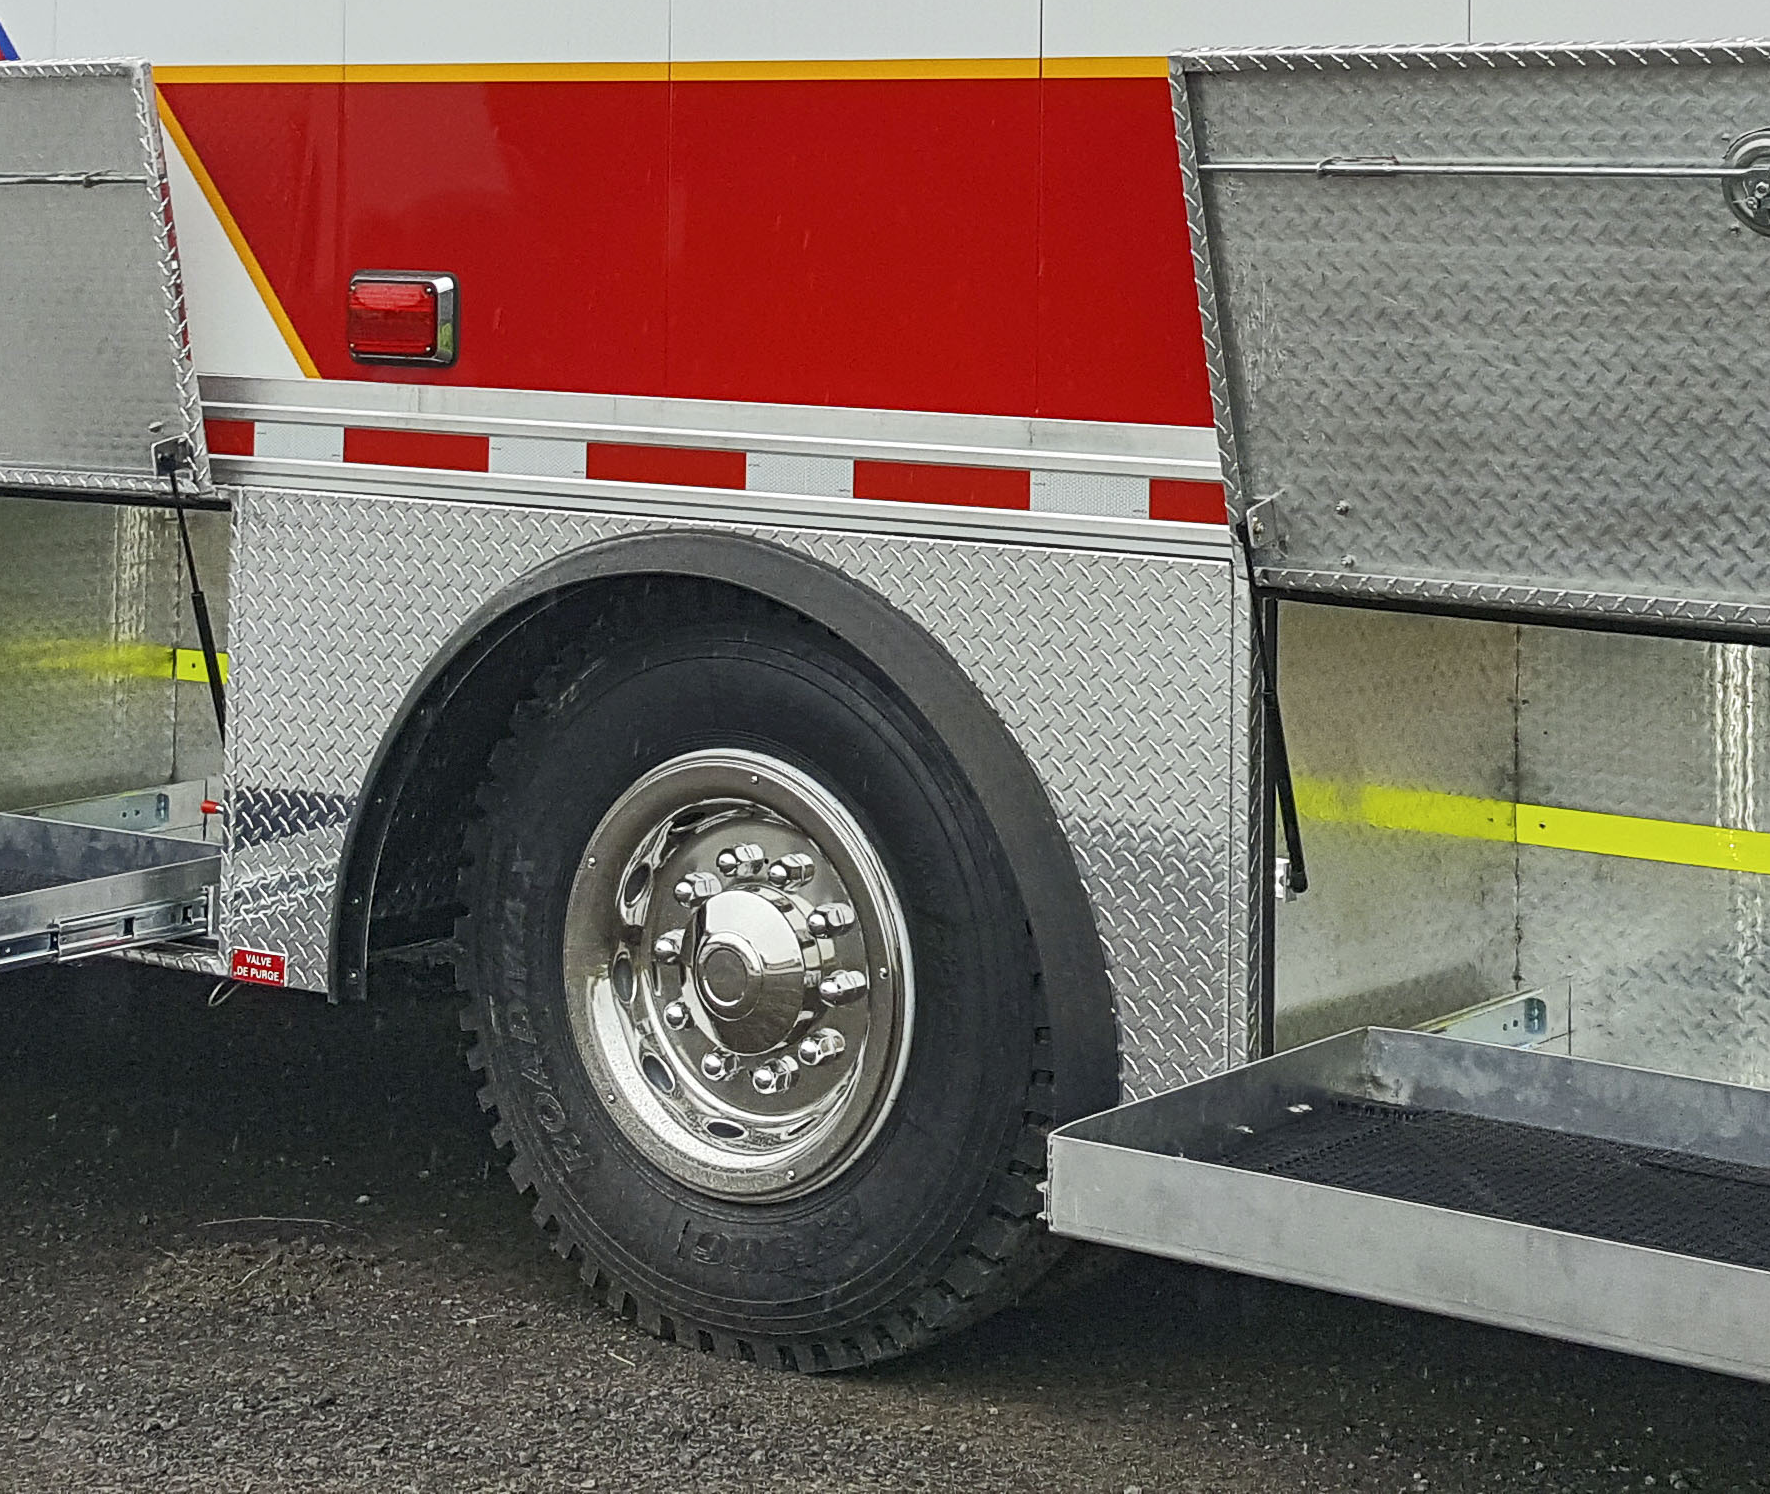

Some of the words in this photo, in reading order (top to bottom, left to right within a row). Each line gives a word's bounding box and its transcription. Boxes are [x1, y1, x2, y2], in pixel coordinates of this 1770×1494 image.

[245, 953, 272, 967] VALVE
[236, 965, 249, 977] DE
[250, 967, 280, 982] PURGE
